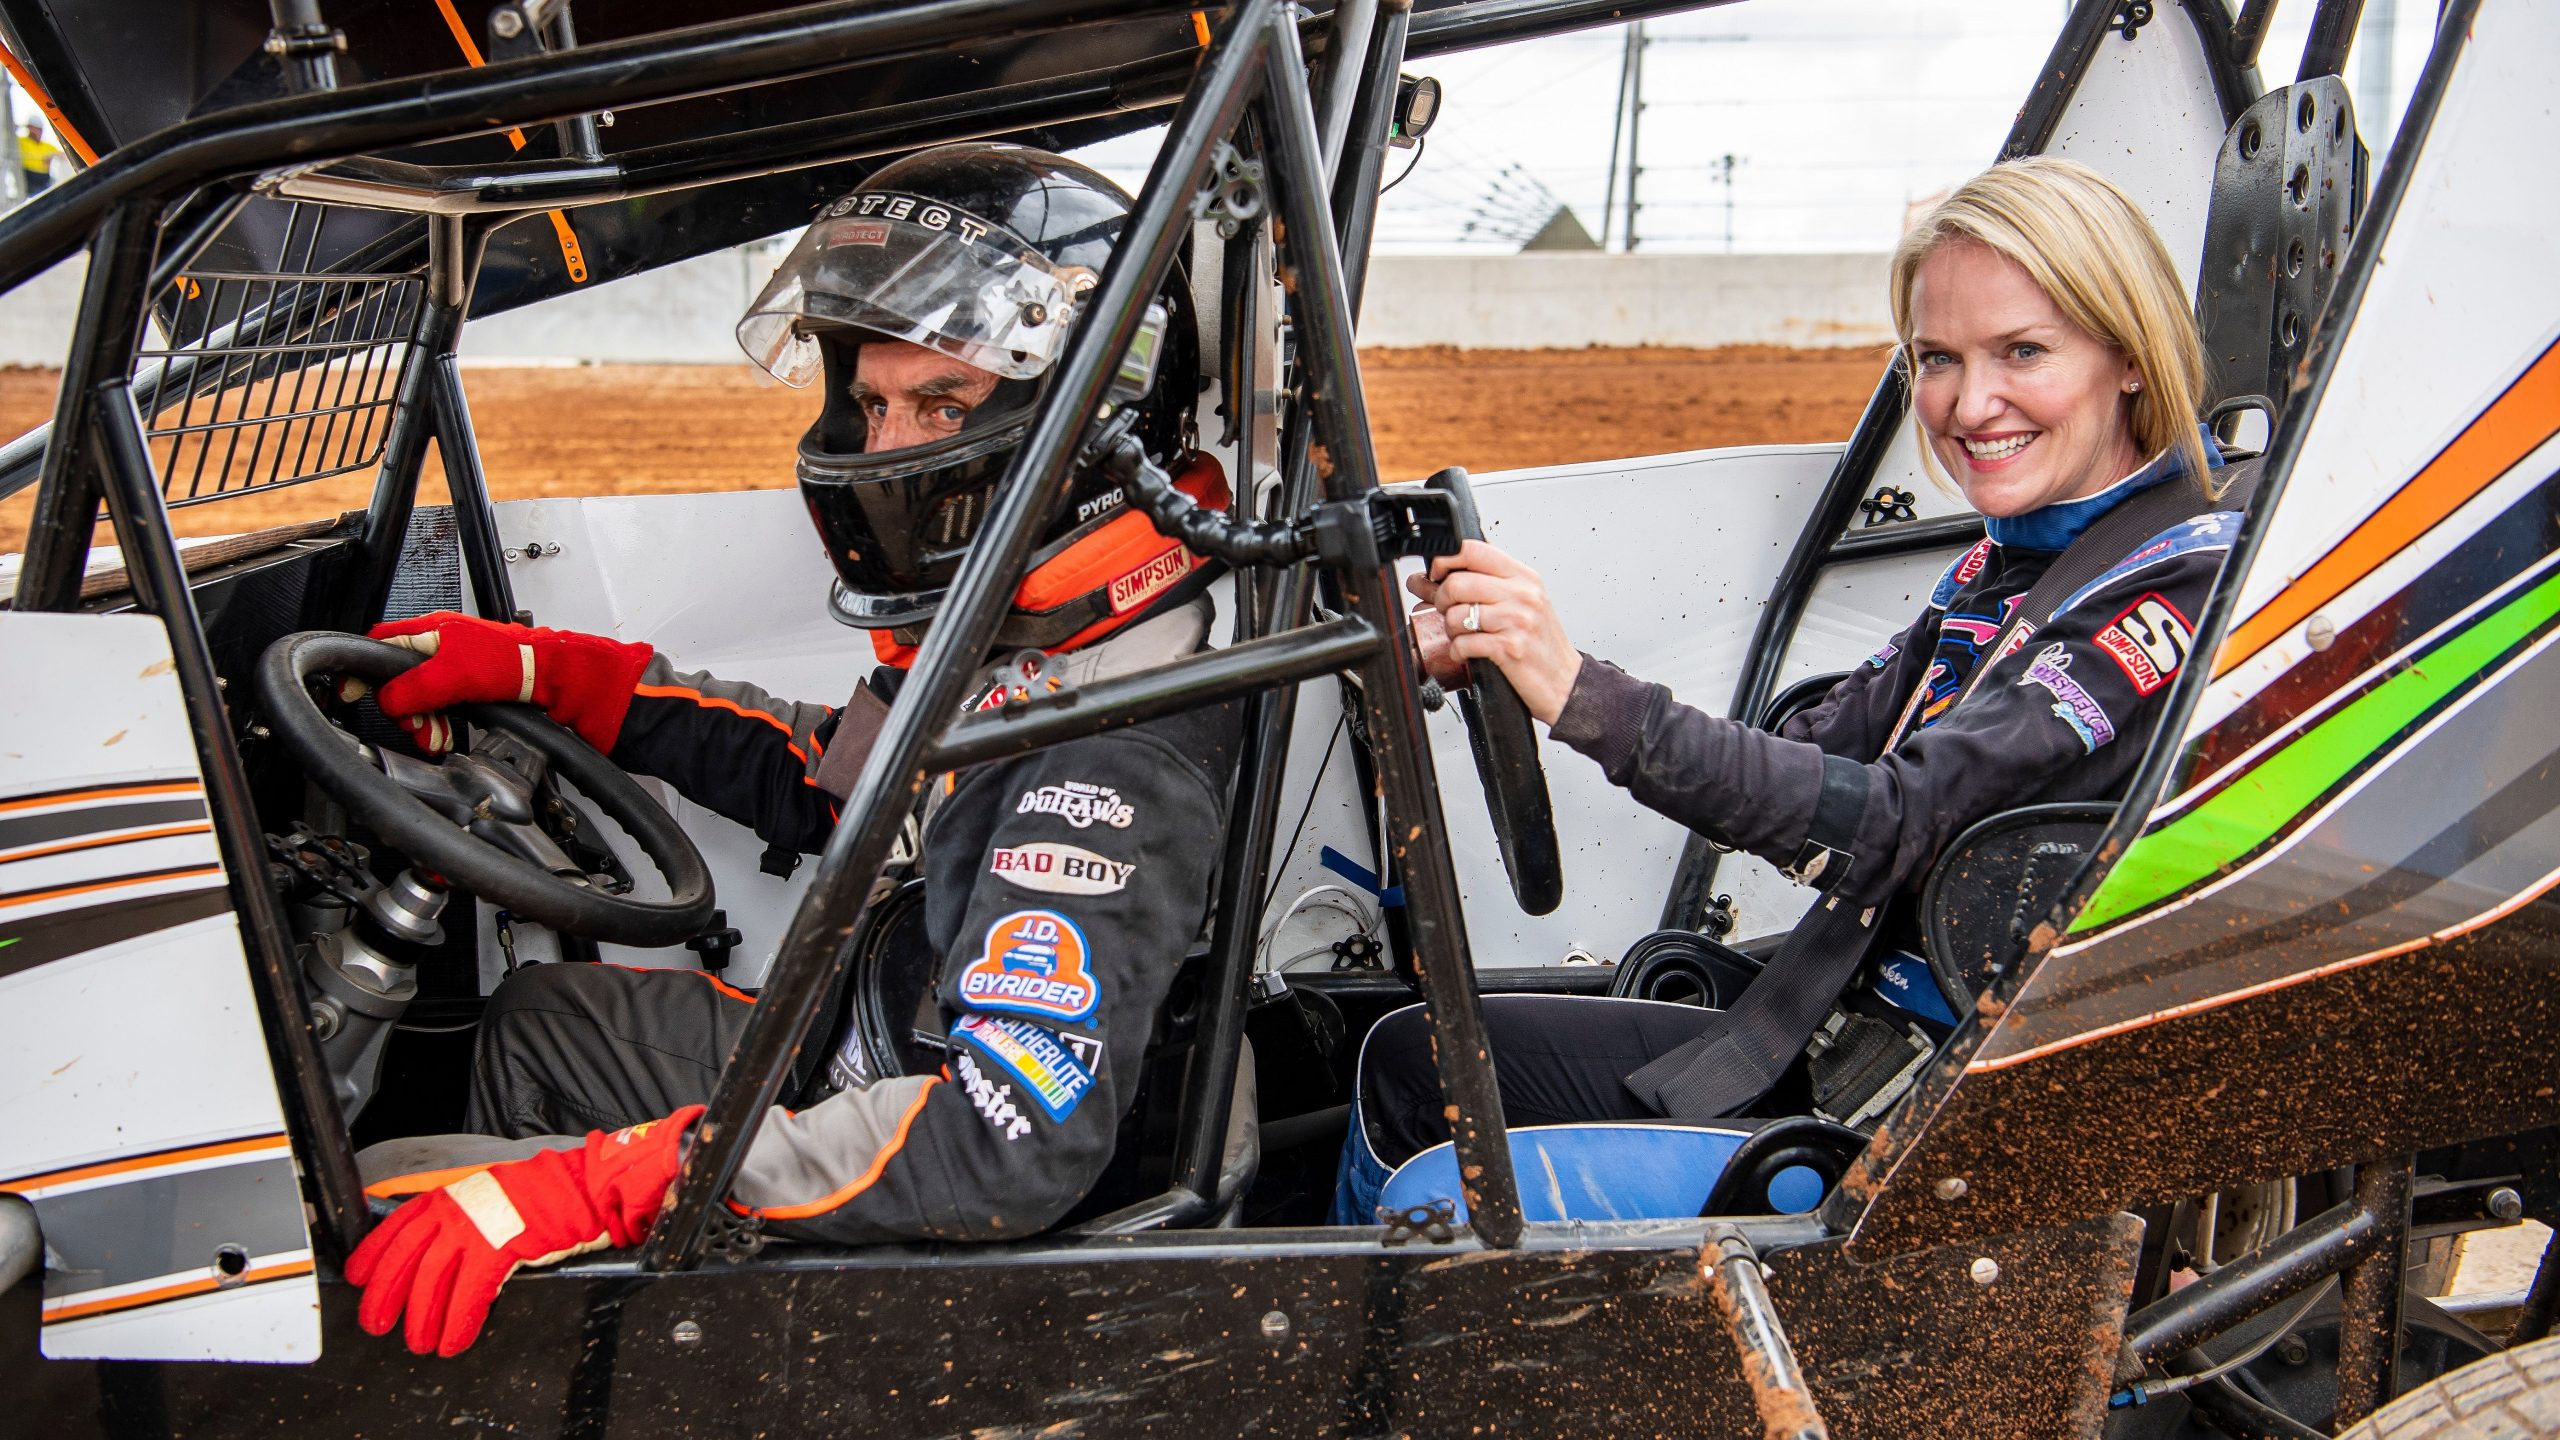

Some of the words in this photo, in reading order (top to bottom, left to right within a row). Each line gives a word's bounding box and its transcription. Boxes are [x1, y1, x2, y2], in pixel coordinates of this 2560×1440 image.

[1078, 487, 1124, 521] PYRO
[1115, 549, 1185, 602] SIMPSON
[2101, 629, 2158, 688] SIMPSON
[1016, 786, 1135, 828] OUTLAWS
[995, 851, 1053, 873] BAD
[1063, 857, 1133, 885] BOY
[1010, 918, 1060, 944] J.D.
[965, 972, 1086, 1009] BYRIDER
[988, 1017, 1090, 1098] EATHERLITE
